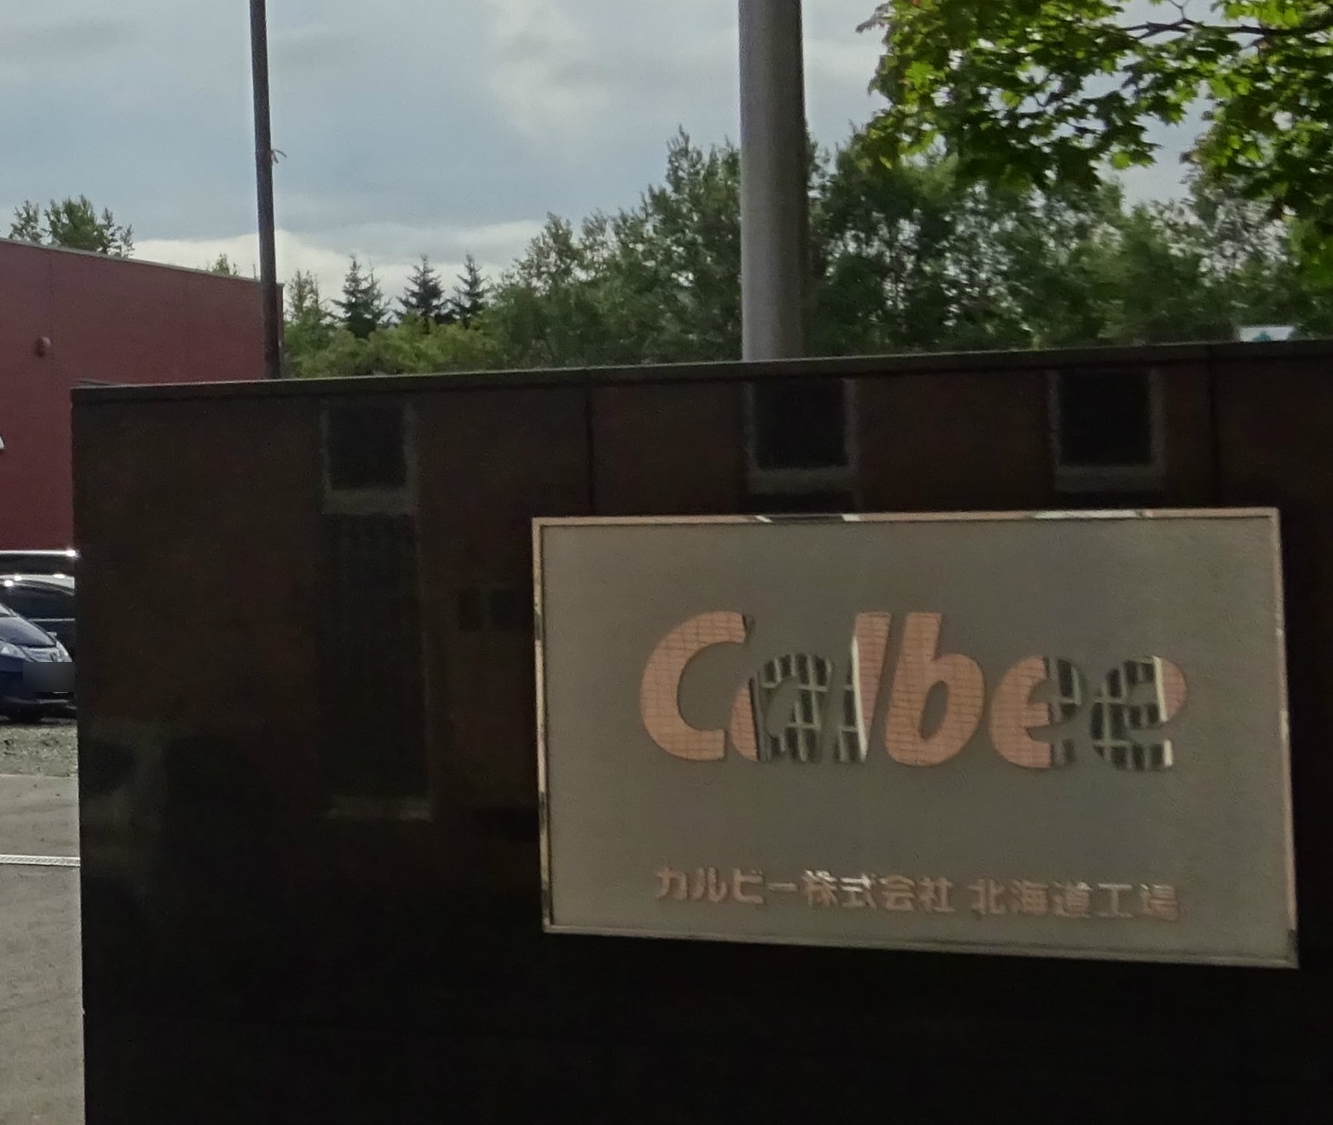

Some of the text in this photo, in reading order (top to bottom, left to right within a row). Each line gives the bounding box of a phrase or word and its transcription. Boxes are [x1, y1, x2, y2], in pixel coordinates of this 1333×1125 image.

[638, 610, 1187, 772] Calbee
[654, 867, 1182, 922] カルビー株式会社 北海道工場
